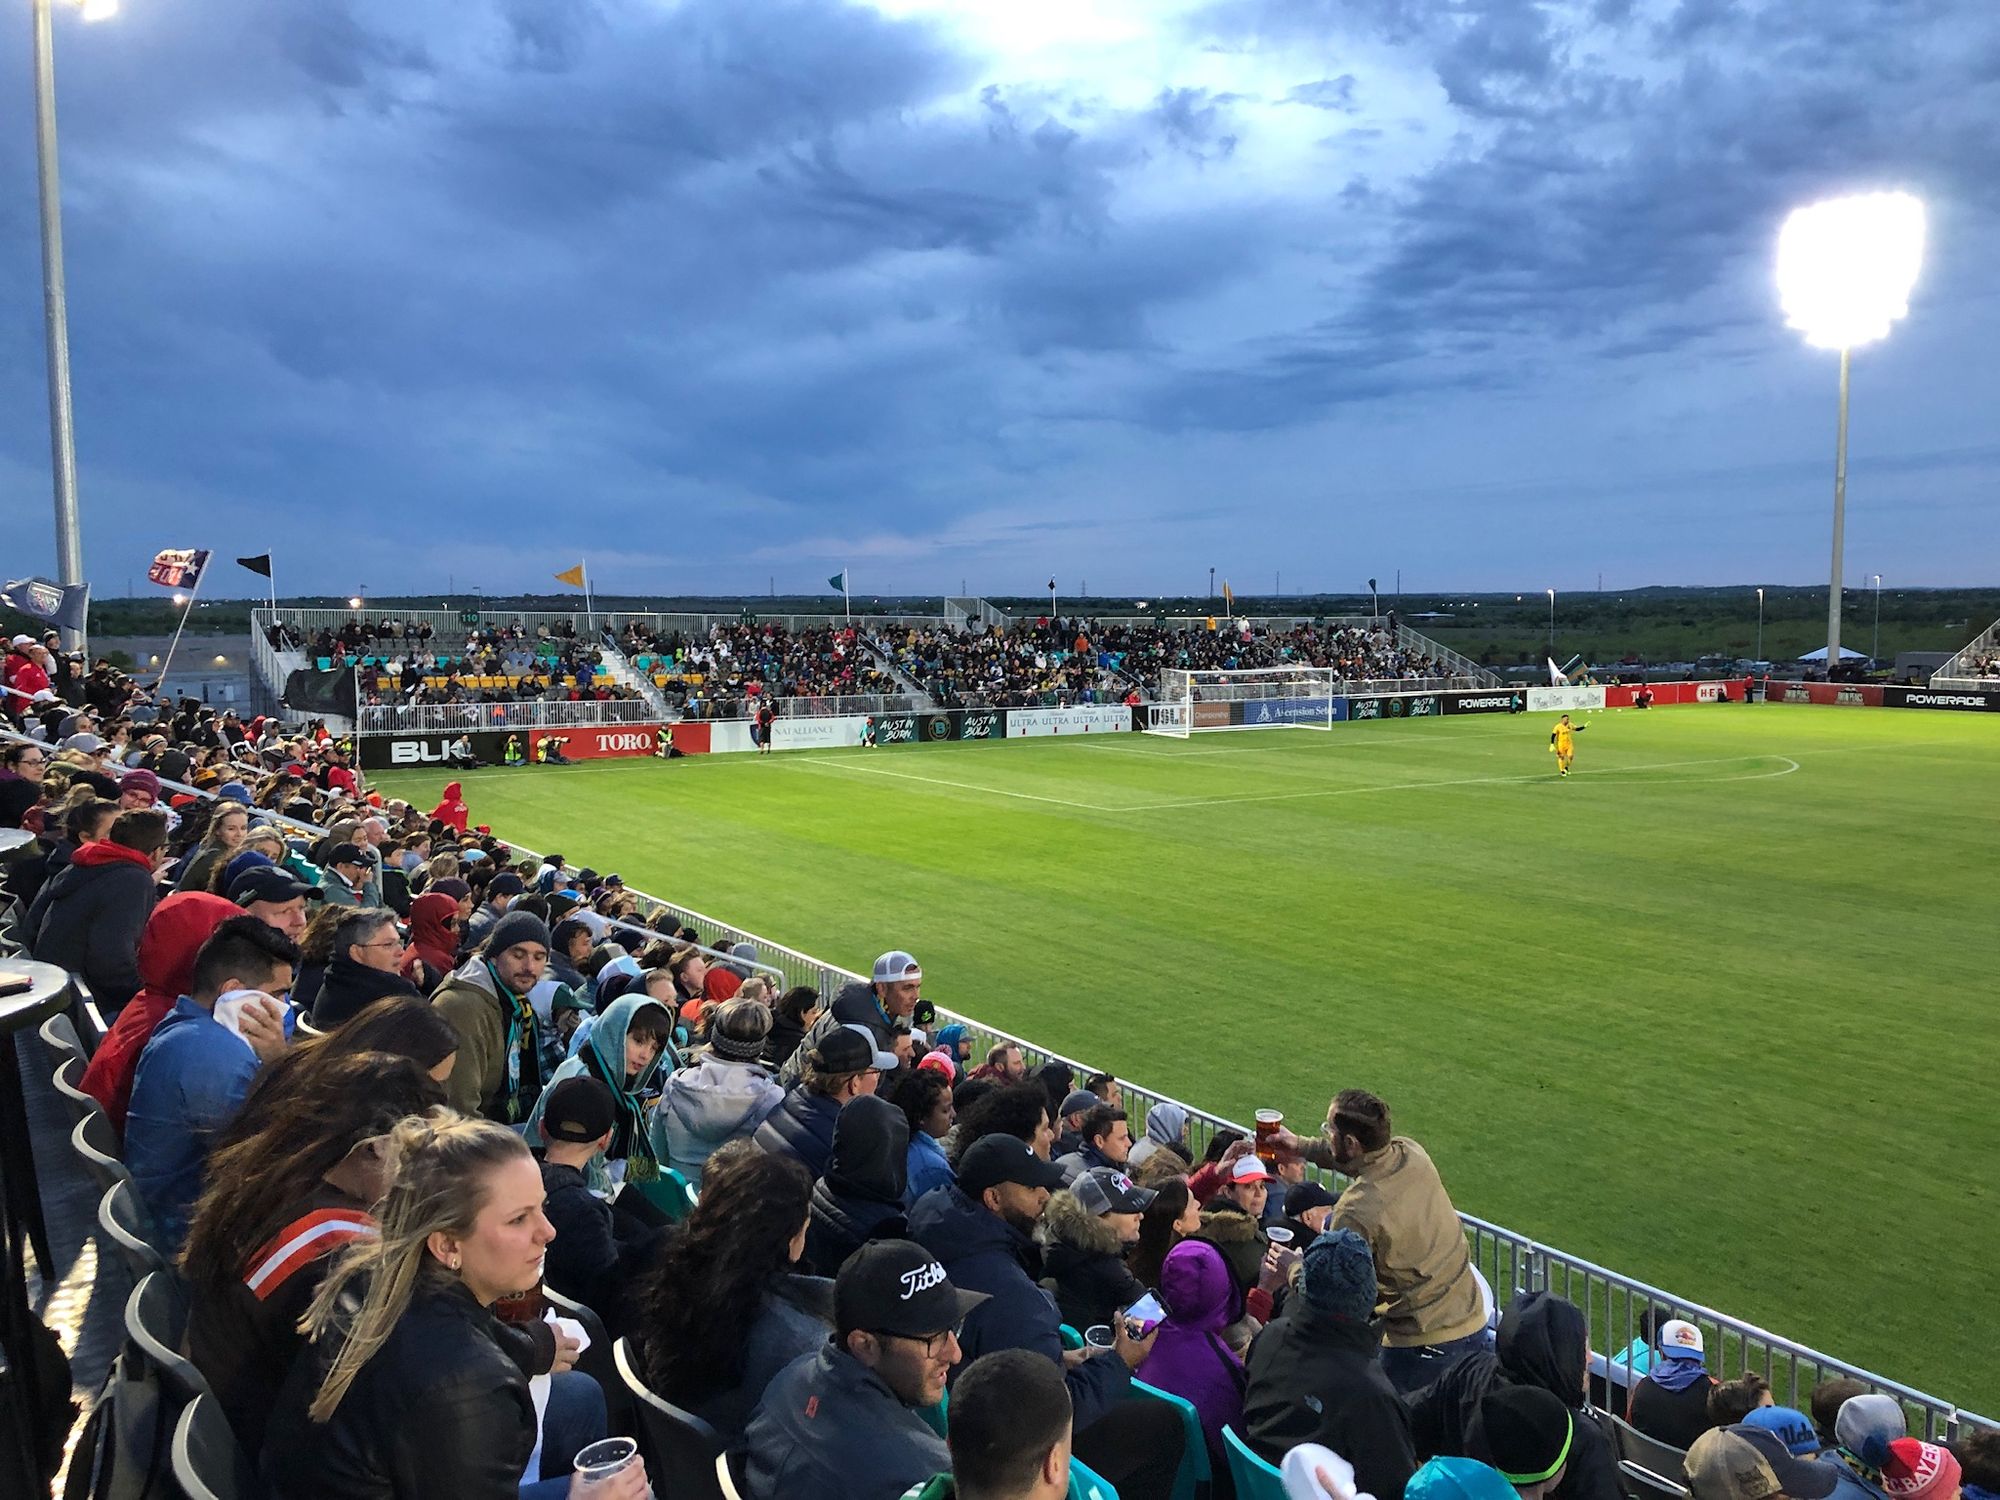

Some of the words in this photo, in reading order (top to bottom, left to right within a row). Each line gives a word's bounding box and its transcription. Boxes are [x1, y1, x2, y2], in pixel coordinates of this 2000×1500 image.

[462, 614, 478, 623] 110
[1355, 700, 1380, 709] AUSTIN
[1411, 697, 1436, 706] AUSTIN
[1458, 697, 1511, 709] POWERADE
[1906, 694, 1986, 707] POWERADE
[1315, 705, 1337, 715] Setn
[880, 718, 915, 730] AUSTIN
[964, 714, 998, 726] AUSTIN
[1010, 719, 1038, 728] ULTRA
[1042, 718, 1069, 726] ULTRA
[1073, 716, 1100, 724] ULTRA
[1103, 715, 1130, 723] ULTRA
[596, 733, 651, 751] TORO
[391, 740, 462, 763] BLK
